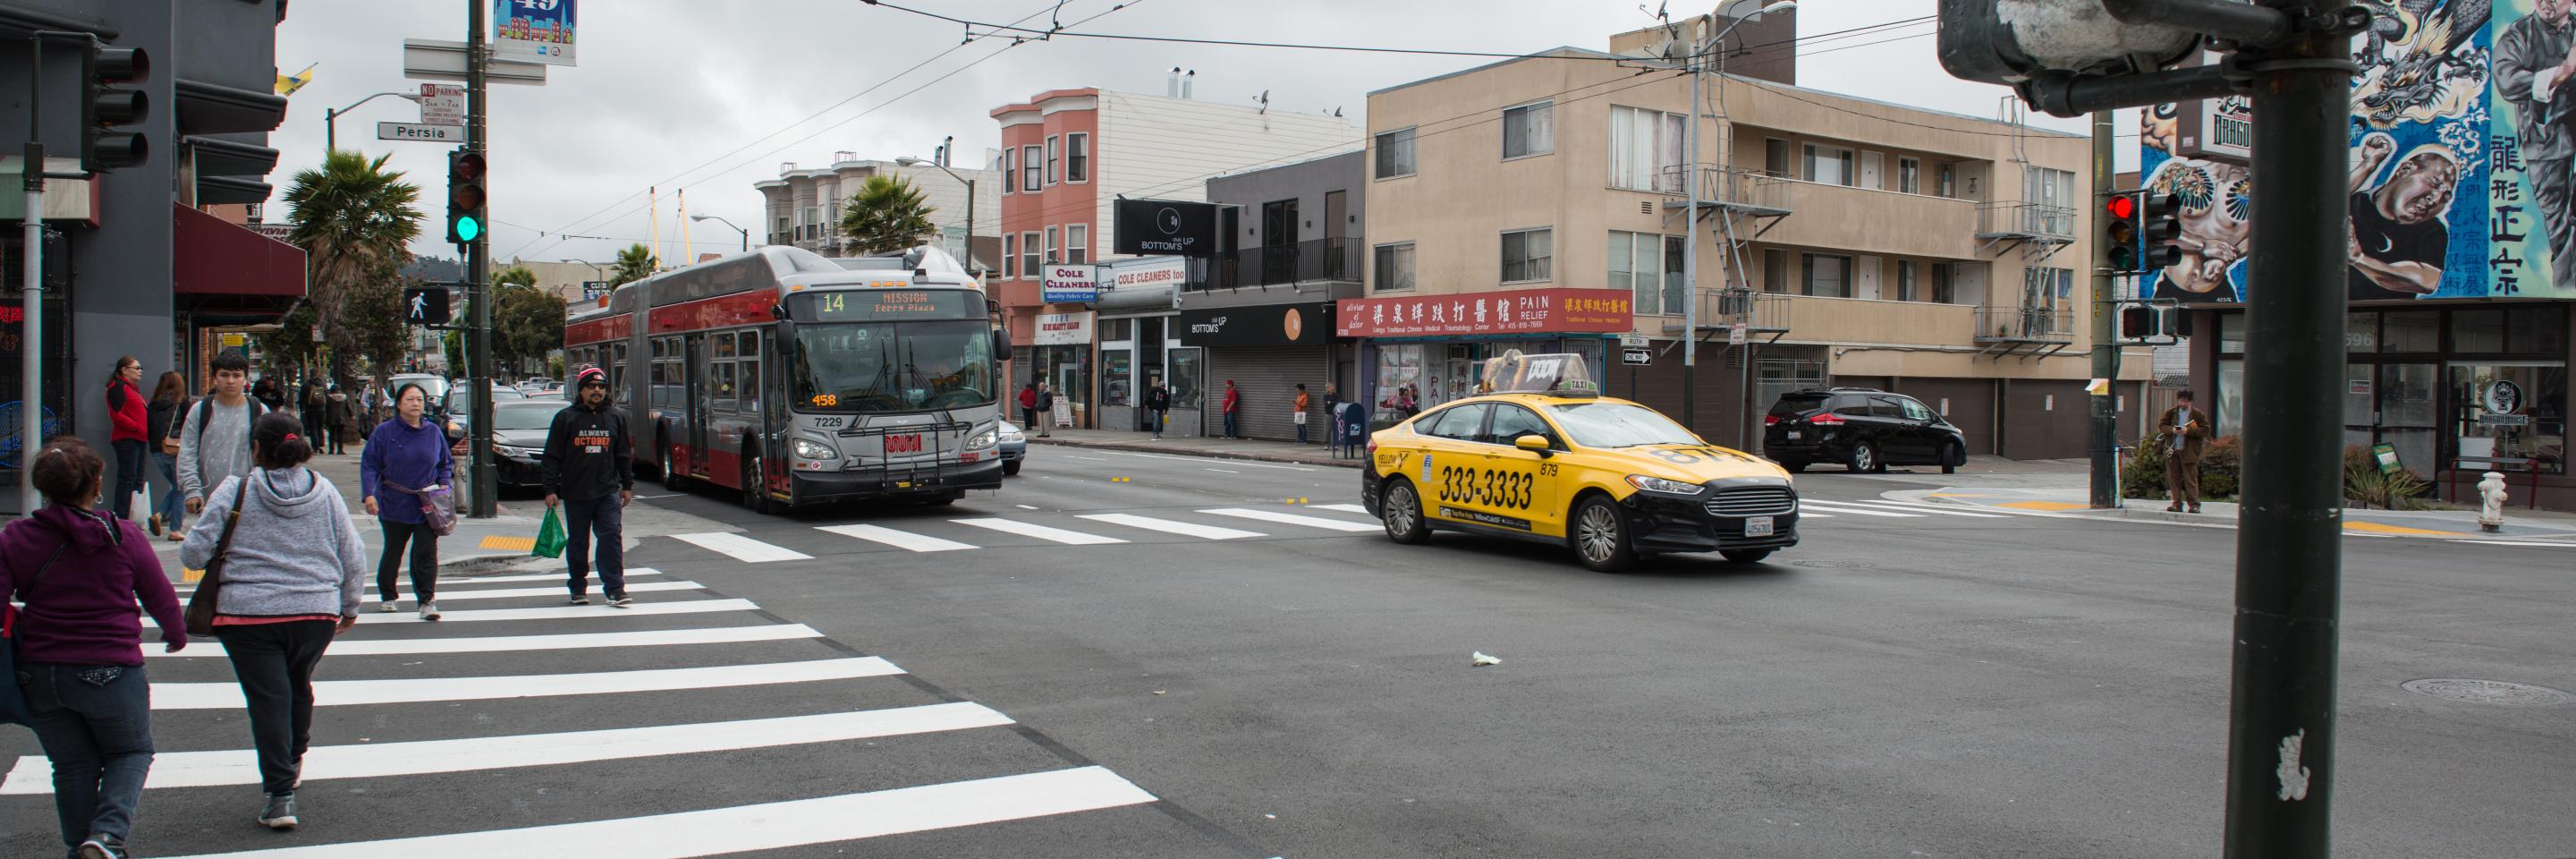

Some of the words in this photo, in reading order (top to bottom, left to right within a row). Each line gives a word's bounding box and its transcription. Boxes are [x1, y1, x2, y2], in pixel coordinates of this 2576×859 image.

[422, 85, 435, 96] NO
[436, 87, 462, 98] PARKING
[397, 126, 445, 138] Persia
[2490, 135, 2526, 295] 龍形正宗
[1141, 241, 1182, 251] BOTTOM'S
[1182, 237, 1194, 245] UP
[1118, 273, 1135, 285] COLE
[1136, 269, 1171, 283] CLEANERS
[1174, 269, 1184, 280] too
[824, 293, 844, 312] 14
[884, 293, 928, 303] MISSION
[1046, 293, 1065, 301] Quality
[1521, 294, 1549, 310] PAIN
[875, 304, 904, 312] Ferry
[1521, 310, 1549, 320] RELIEF
[1191, 323, 1219, 334] BOTTOM'S
[1218, 316, 1227, 326] UP
[1474, 323, 1490, 331] Center
[1572, 380, 1588, 389] TAXI
[812, 395, 837, 406] 458
[815, 417, 843, 428] 7229
[1378, 454, 1397, 464] YELLOW
[1539, 463, 1558, 477] 879
[1440, 465, 1533, 511] 333-3333
